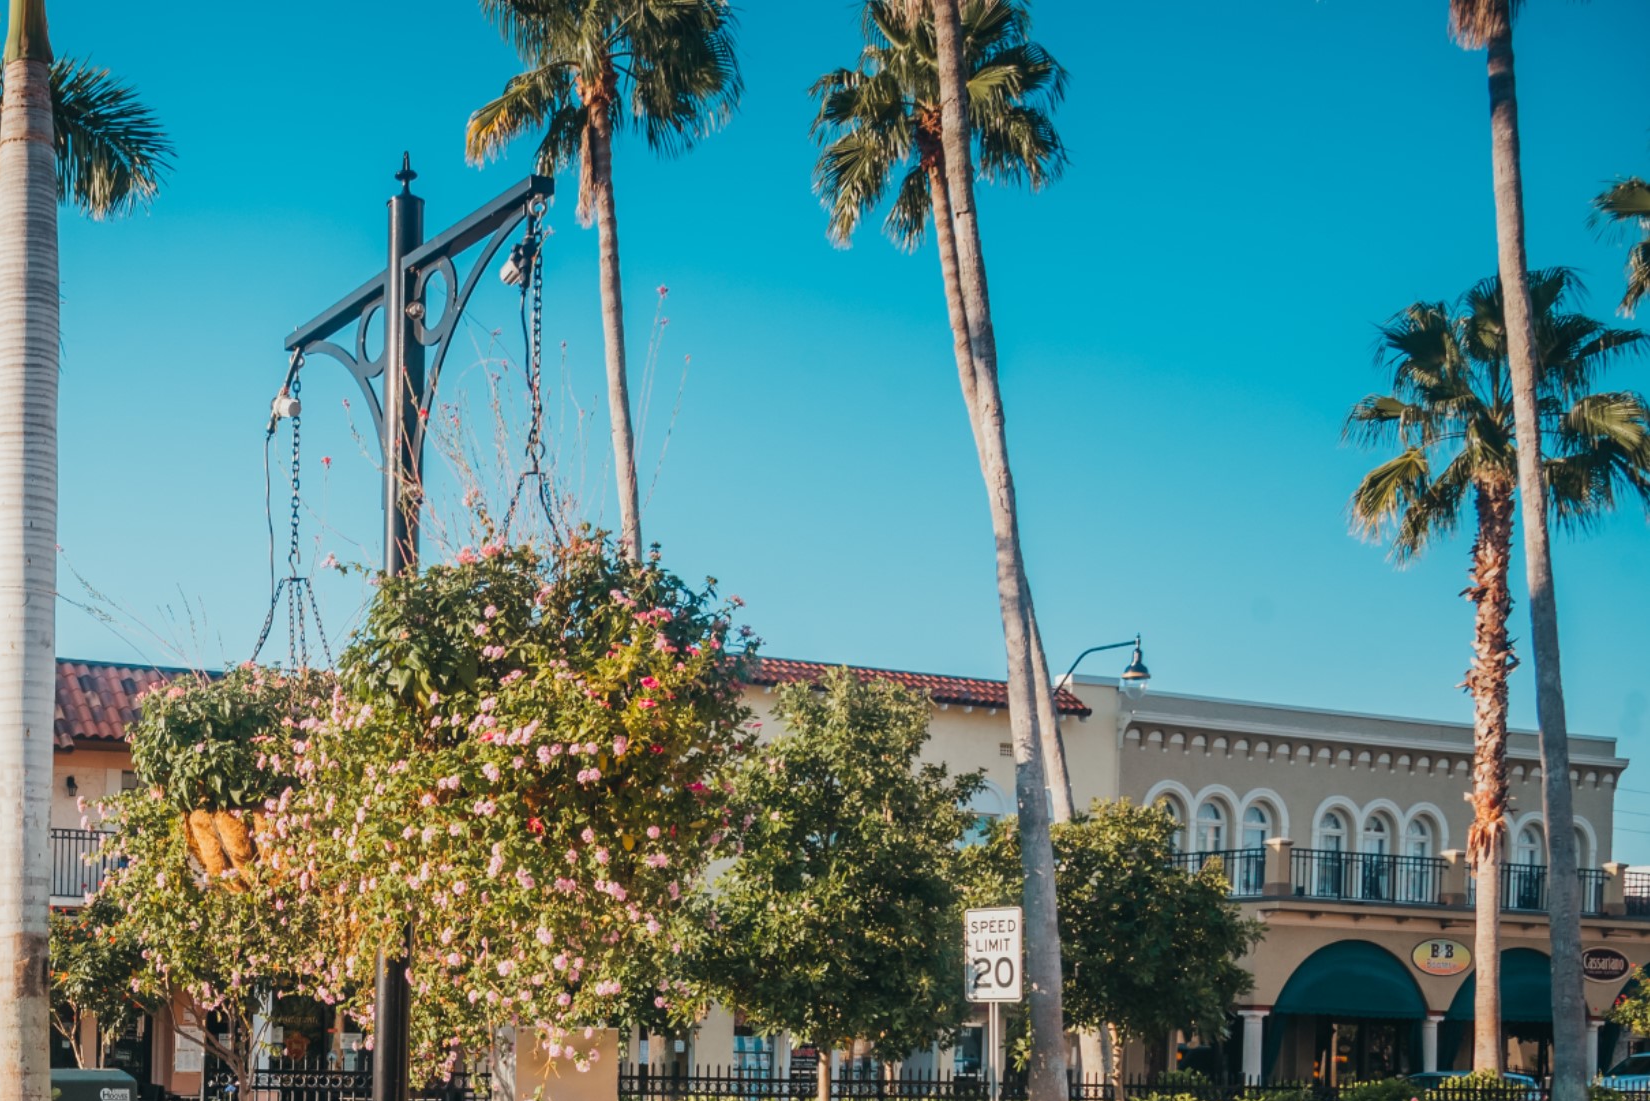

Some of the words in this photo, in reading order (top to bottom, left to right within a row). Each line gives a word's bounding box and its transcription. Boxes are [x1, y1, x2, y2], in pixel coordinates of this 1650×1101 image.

[971, 919, 1016, 934] SPEED
[975, 938, 1011, 952] LIMIT
[973, 956, 1015, 989] 20
